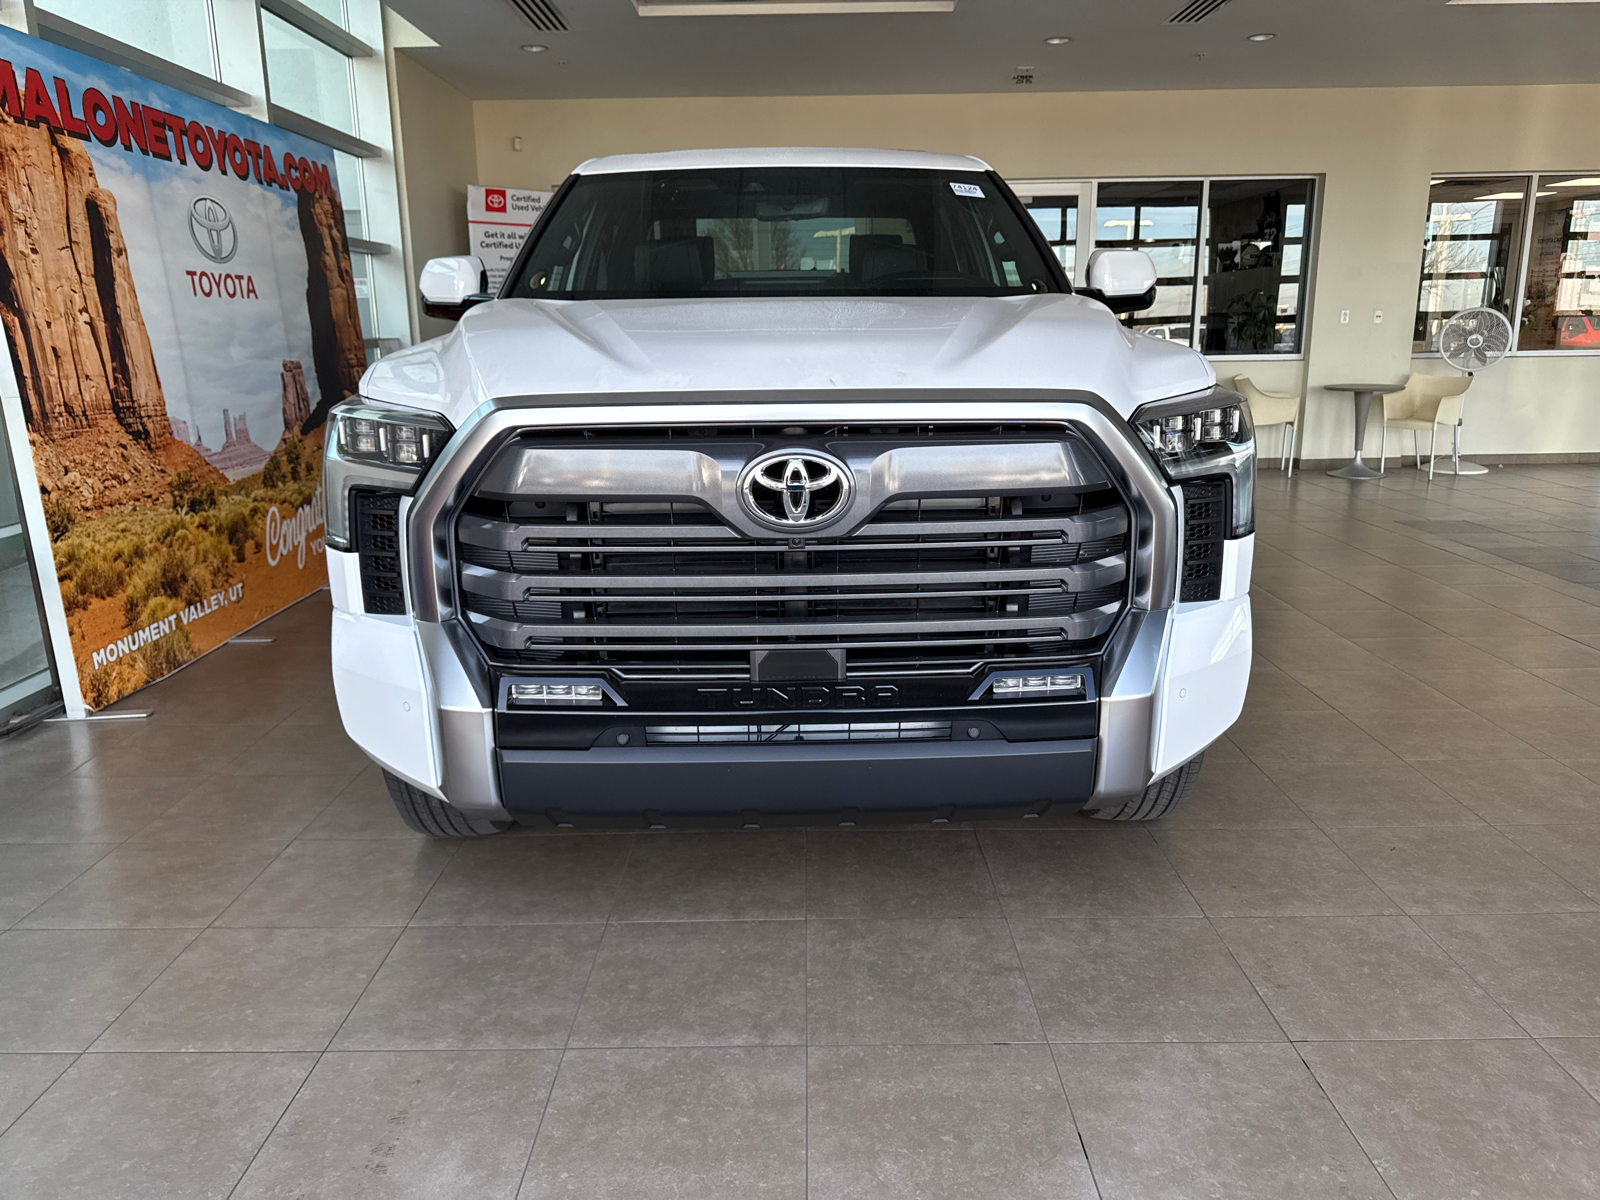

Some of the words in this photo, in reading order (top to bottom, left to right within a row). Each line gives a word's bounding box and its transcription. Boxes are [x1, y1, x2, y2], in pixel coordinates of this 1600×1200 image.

[511, 194, 541, 203] Certified
[511, 203, 530, 211] Used
[484, 230, 498, 239] Get
[499, 231, 506, 239] it
[507, 231, 517, 240] all
[480, 241, 514, 250] Certified
[185, 270, 259, 300] TOYOTA
[92, 613, 178, 670] MONUMENT
[179, 591, 229, 626] VALLEY,
[228, 582, 244, 602] UT
[697, 684, 901, 709] TUNDRA
